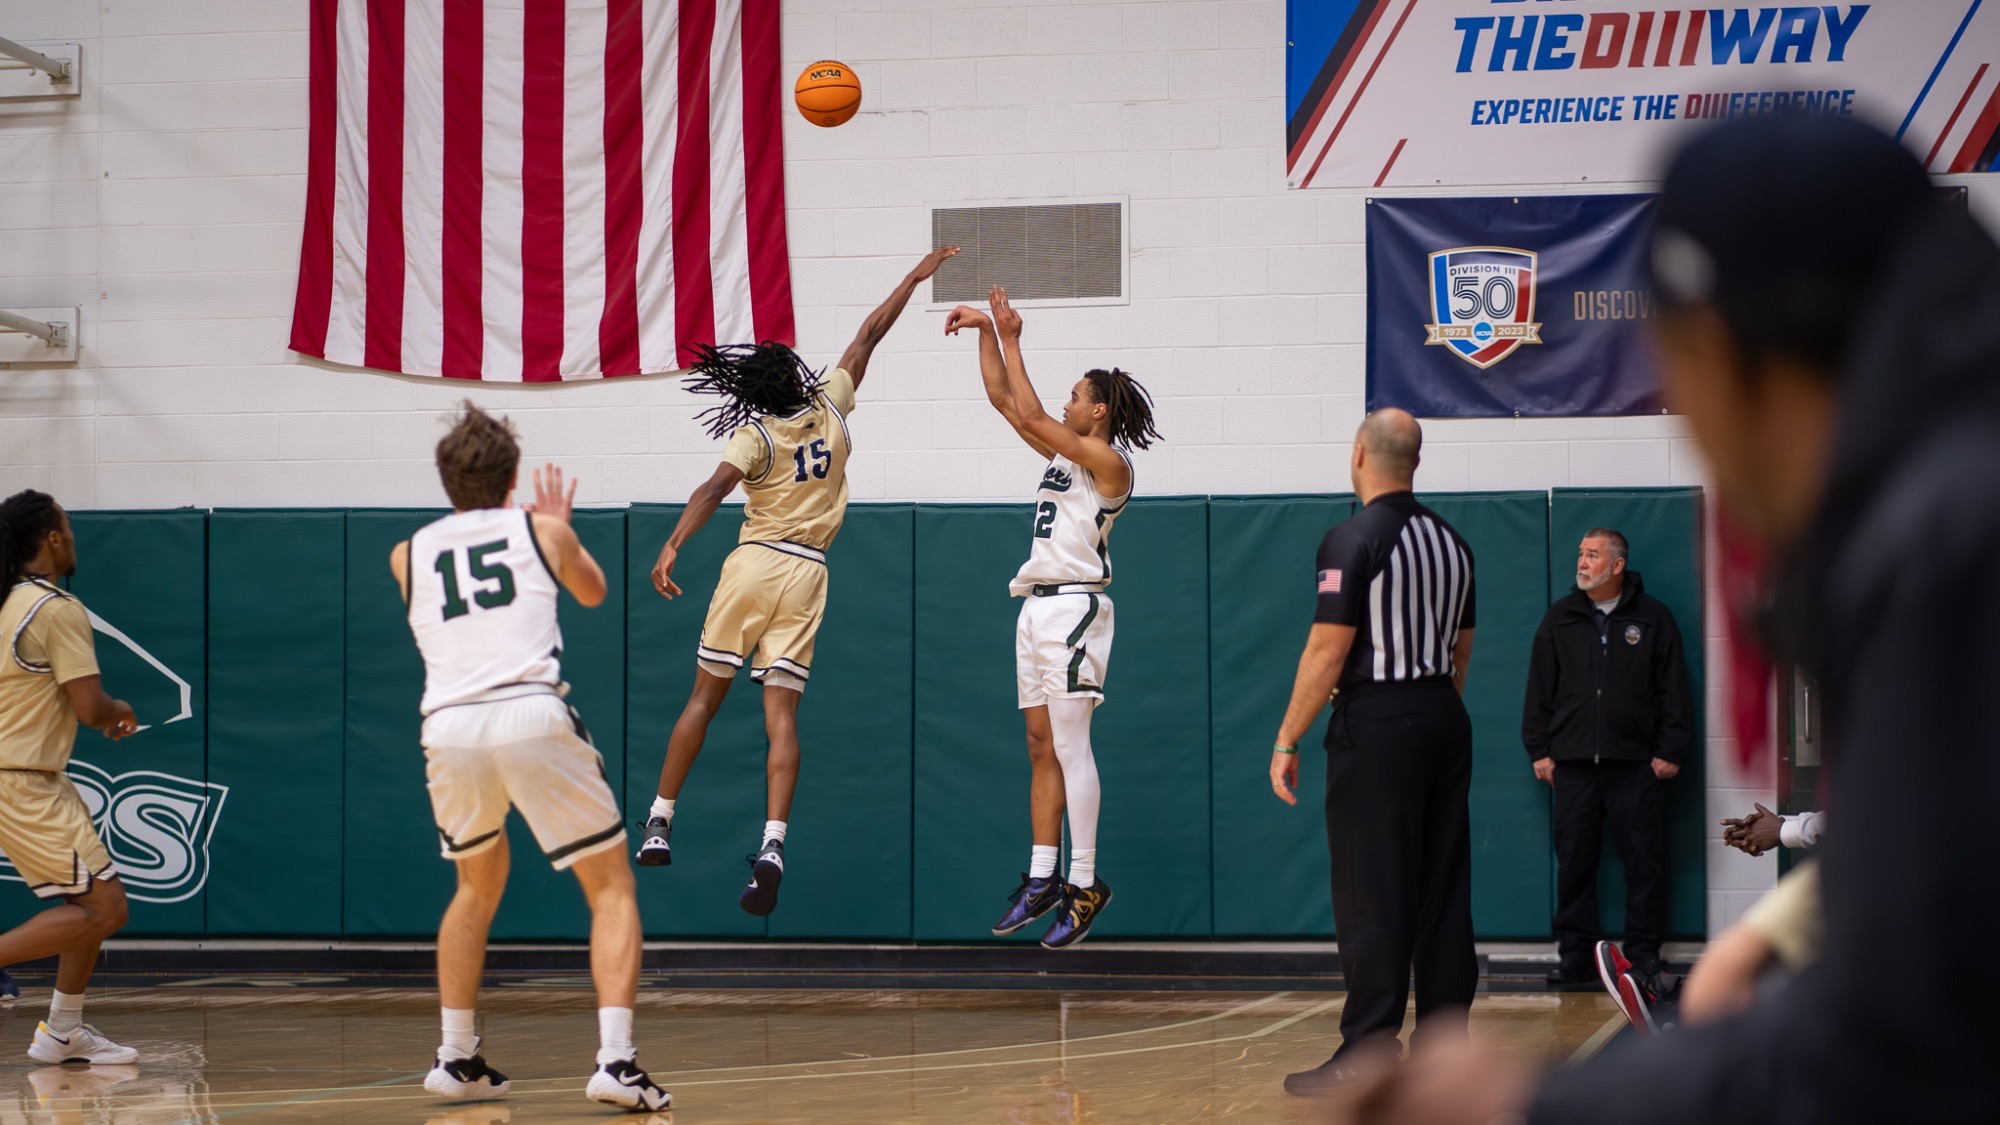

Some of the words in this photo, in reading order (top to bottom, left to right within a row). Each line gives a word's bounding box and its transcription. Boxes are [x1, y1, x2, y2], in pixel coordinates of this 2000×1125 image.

[810, 69, 842, 80] NCAA
[1471, 96, 1626, 126] EXPERIENCE
[1632, 95, 1680, 121] THE
[1450, 265, 1500, 276] DIVISION
[1504, 267, 1516, 275] III
[1452, 275, 1516, 320] 50
[1574, 289, 1662, 321] DISCOV
[1443, 327, 1467, 337] 1973
[1498, 326, 1524, 336] 2023
[793, 437, 832, 483] 15
[1034, 500, 1058, 539] 2
[434, 536, 517, 622] 15
